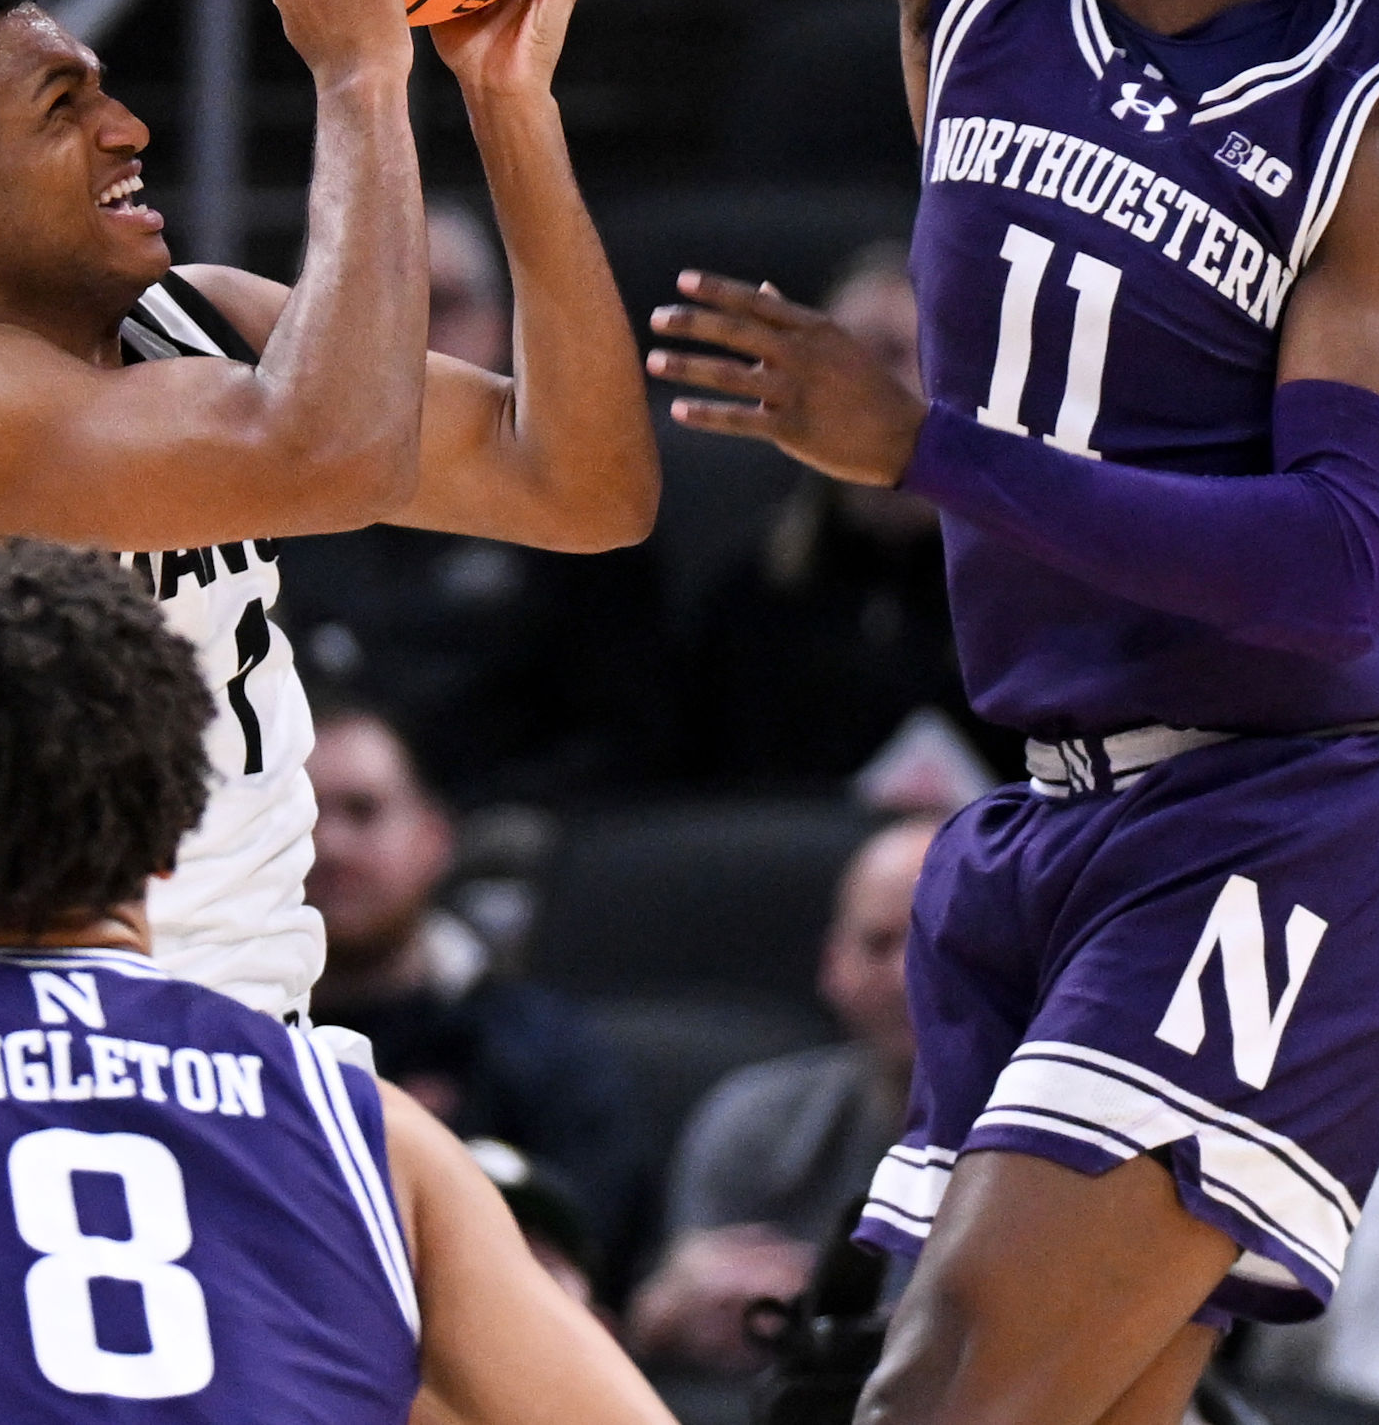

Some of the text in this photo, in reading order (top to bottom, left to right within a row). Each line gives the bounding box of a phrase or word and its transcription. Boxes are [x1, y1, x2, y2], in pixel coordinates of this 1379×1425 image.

[931, 117, 1296, 330] NORTHWESTERN
[976, 224, 1123, 461] 11
[1060, 738, 1096, 794] N
[29, 971, 106, 1029] N
[1154, 874, 1329, 1092] N
[8, 1127, 215, 1400] 8
